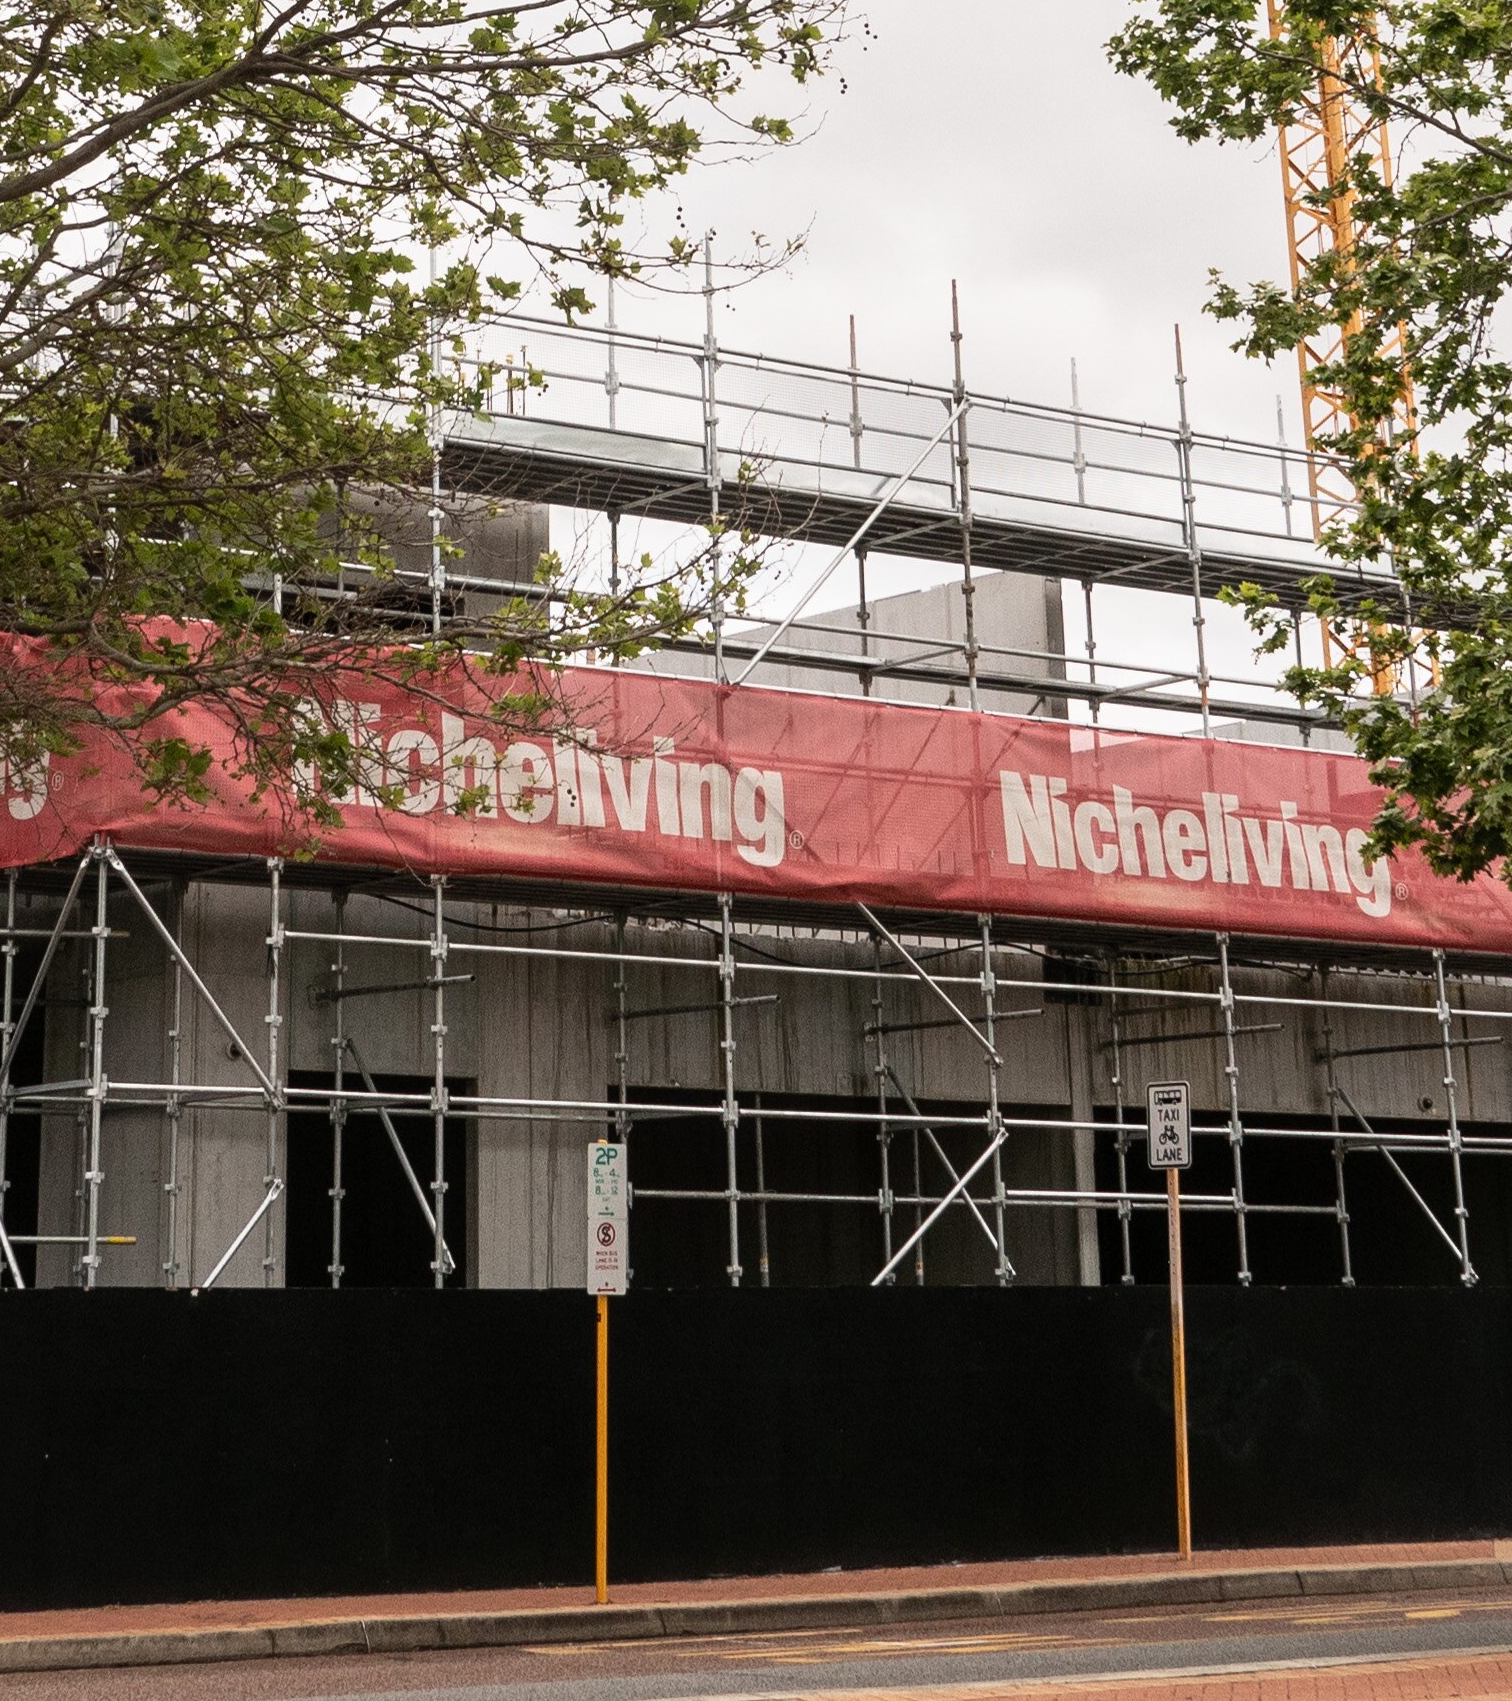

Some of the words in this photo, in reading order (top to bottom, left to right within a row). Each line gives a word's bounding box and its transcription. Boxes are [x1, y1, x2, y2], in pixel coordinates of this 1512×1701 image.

[999, 769, 1391, 918] Nicheliving
[1157, 1108, 1180, 1122] TAXI
[595, 1147, 618, 1166] 2P
[1156, 1147, 1183, 1161] LANE
